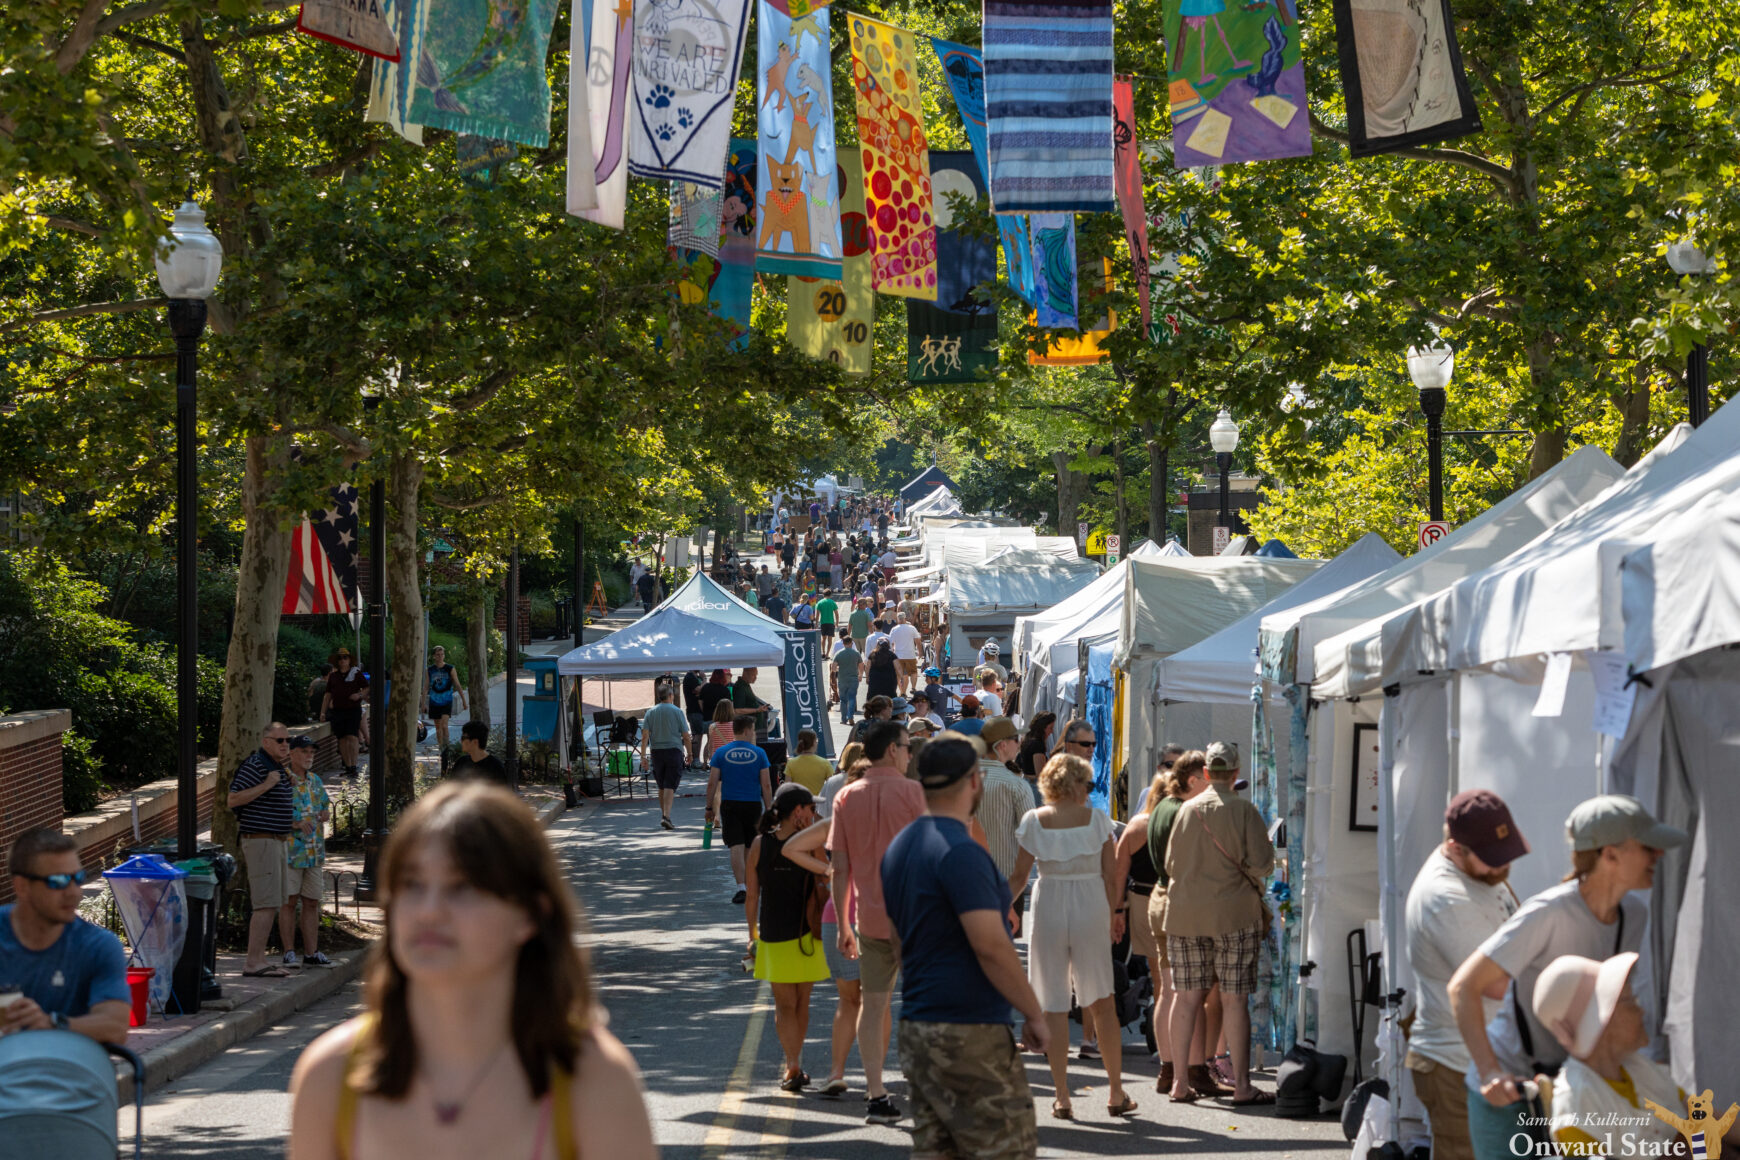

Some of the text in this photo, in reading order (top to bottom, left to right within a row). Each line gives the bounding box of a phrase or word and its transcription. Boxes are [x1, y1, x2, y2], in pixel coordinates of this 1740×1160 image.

[636, 35, 727, 74] WE ARE
[818, 291, 846, 316] 20
[843, 322, 867, 344] 10
[785, 631, 814, 730] uraleaf
